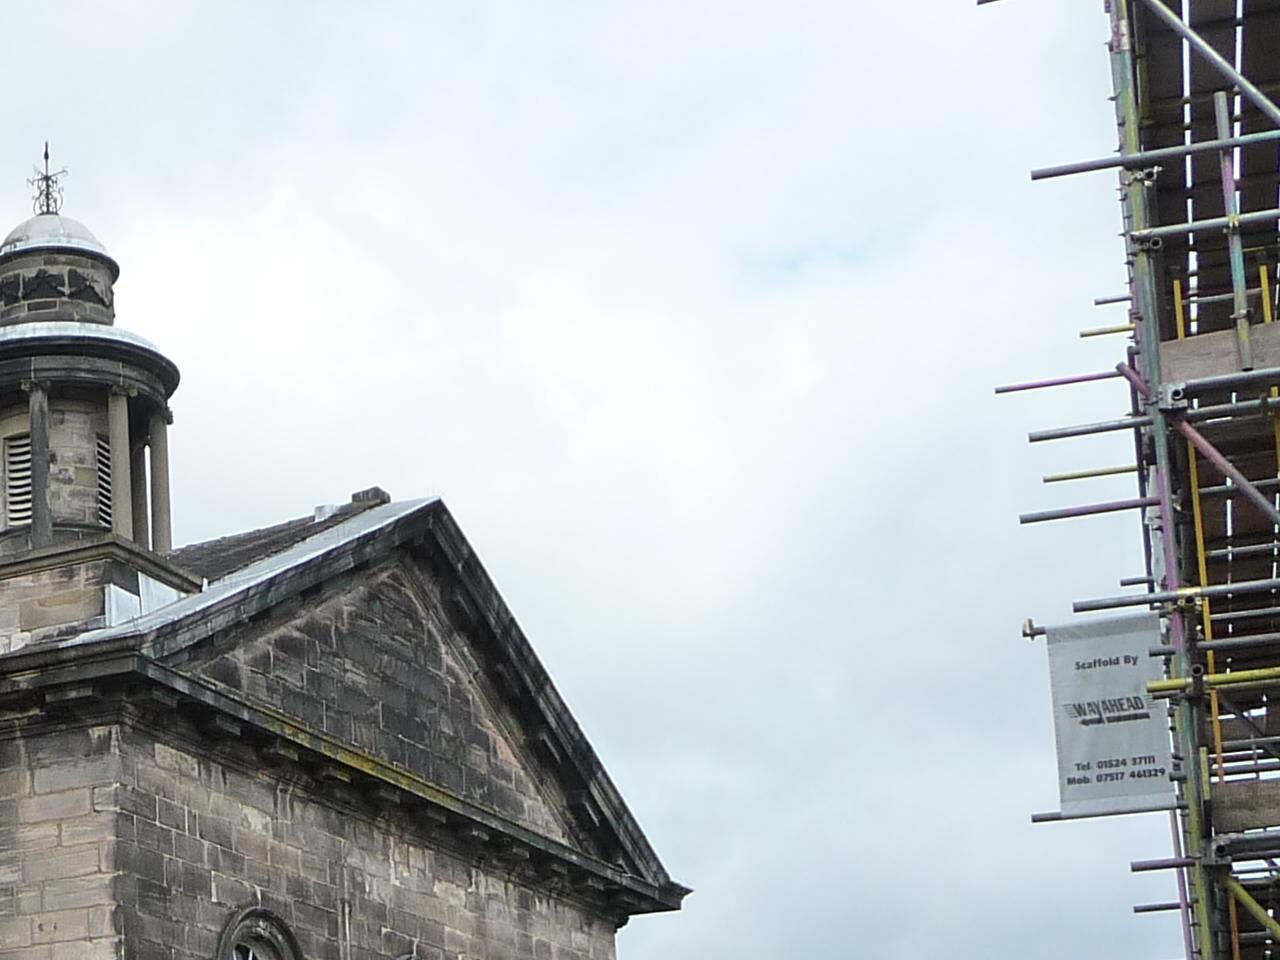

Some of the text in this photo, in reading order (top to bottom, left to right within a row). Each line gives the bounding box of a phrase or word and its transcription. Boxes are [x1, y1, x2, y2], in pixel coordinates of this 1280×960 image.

[1075, 654, 1139, 670] Scaffold By
[1073, 696, 1145, 718] WAYAHEAD
[1096, 758, 1127, 769] 01524
